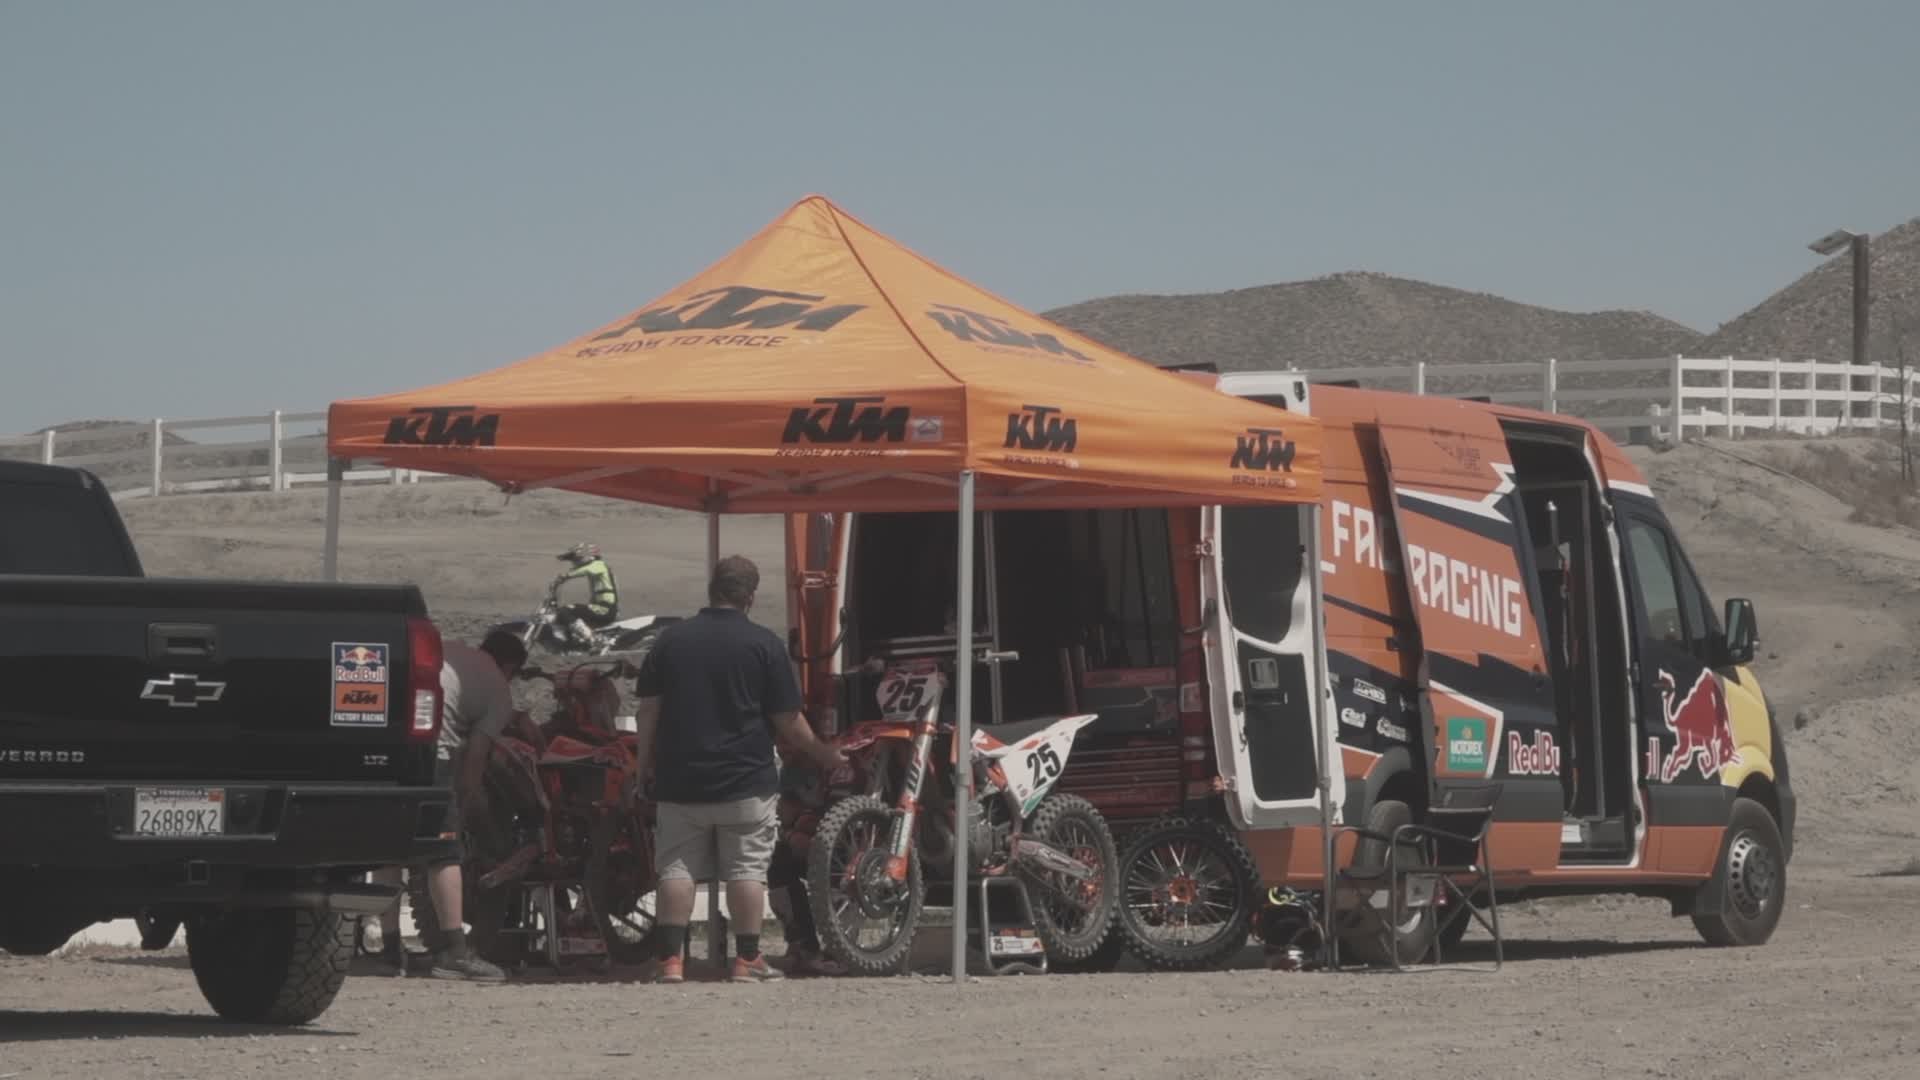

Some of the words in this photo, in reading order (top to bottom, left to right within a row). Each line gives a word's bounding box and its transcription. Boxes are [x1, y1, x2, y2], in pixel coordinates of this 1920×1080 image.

[590, 286, 869, 343] KTM
[668, 335, 699, 347] TO
[706, 334, 788, 349] RACE
[384, 405, 501, 446] KTM
[782, 397, 911, 443] KTM
[1002, 405, 1077, 454] KTM
[1230, 428, 1296, 472] KTM
[341, 690, 379, 704] KTM
[885, 678, 926, 712] 25
[1026, 743, 1062, 791] 25
[140, 809, 218, 833] 26889K2
